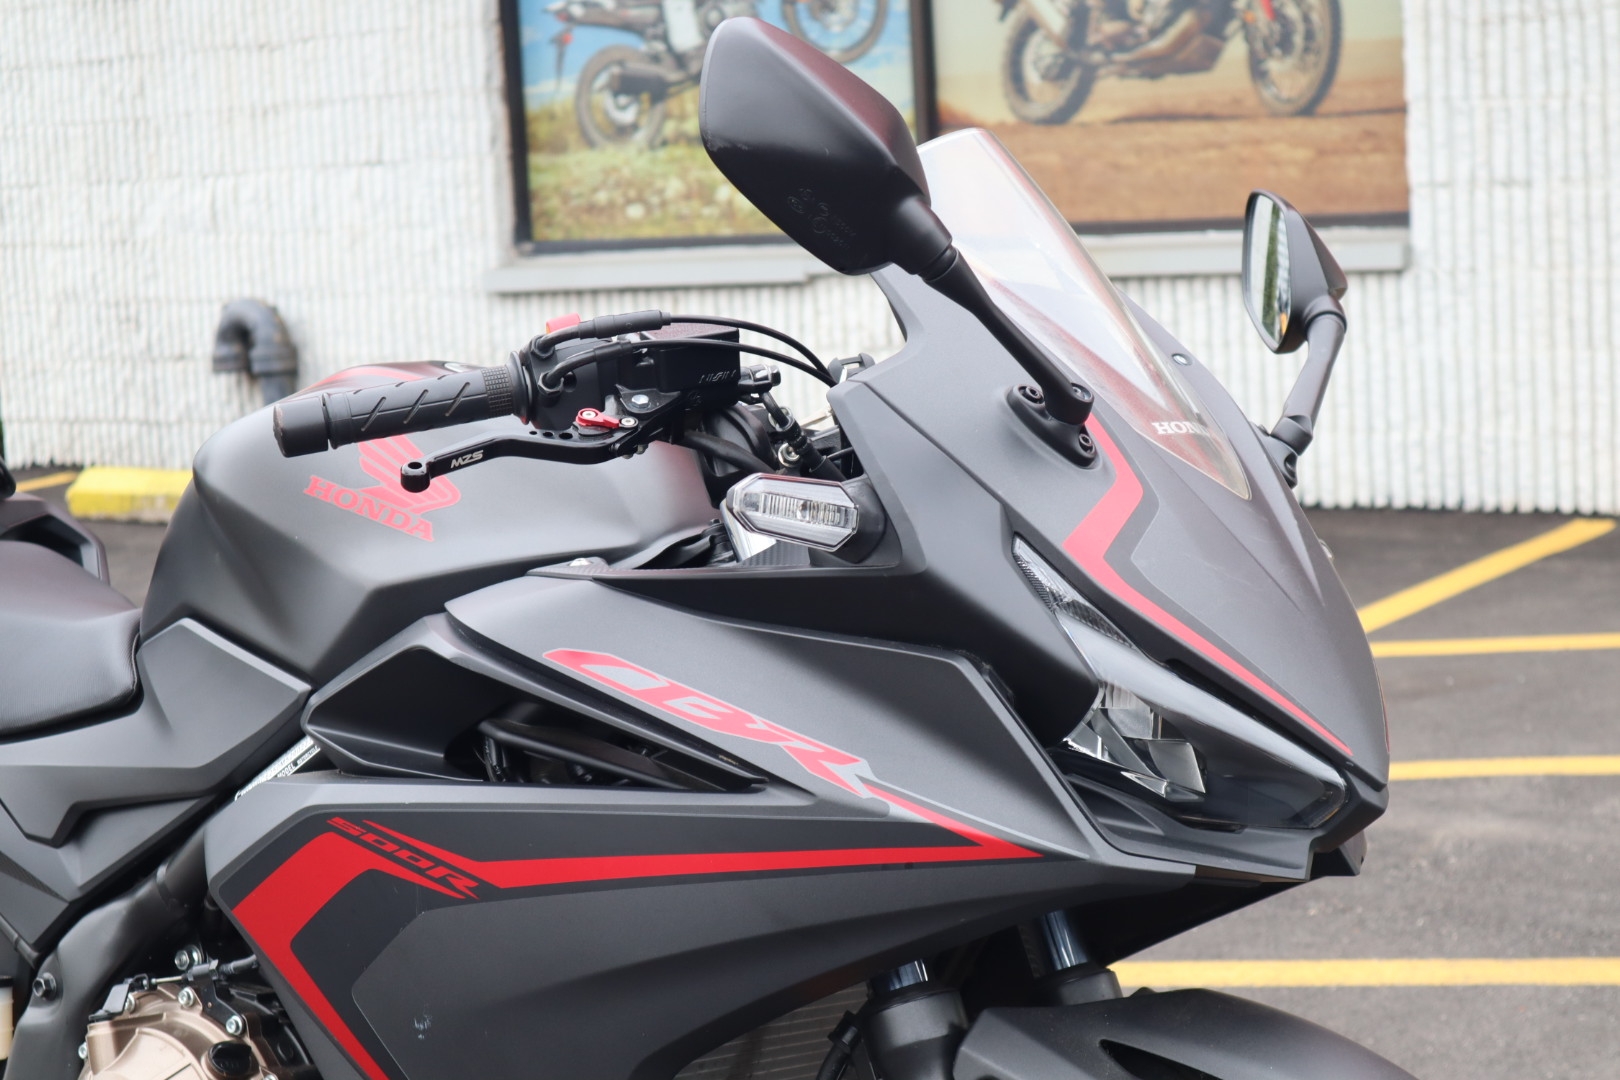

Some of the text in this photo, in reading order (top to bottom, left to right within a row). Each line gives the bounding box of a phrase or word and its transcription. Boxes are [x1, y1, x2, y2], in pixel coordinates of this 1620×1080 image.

[450, 449, 484, 469] MZS
[303, 475, 435, 542] HONDA
[542, 648, 867, 799] CBR
[326, 816, 481, 901] 500R
